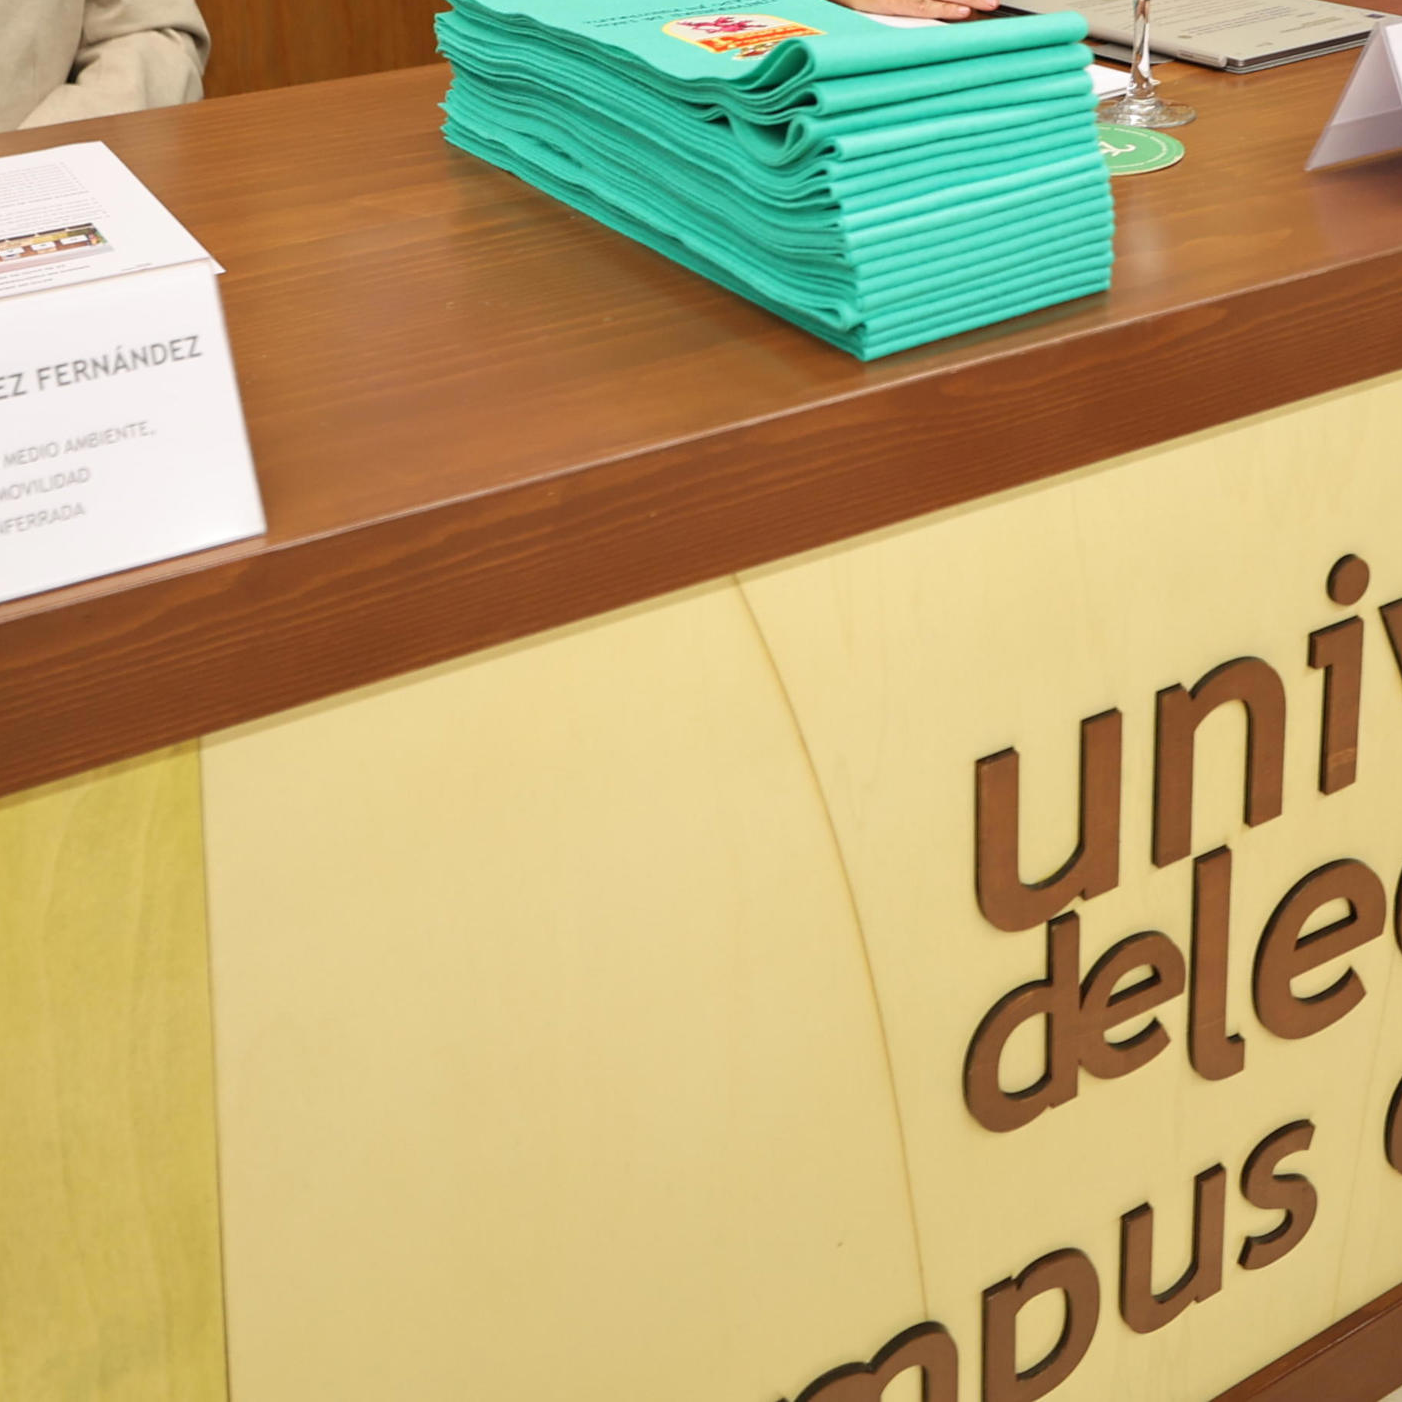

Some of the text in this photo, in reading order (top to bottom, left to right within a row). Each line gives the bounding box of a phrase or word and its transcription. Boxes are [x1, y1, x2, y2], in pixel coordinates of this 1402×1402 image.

[36, 335, 203, 391] FERNÁNDEZ
[3, 442, 60, 468] MEDIO
[962, 910, 1186, 1133] de
